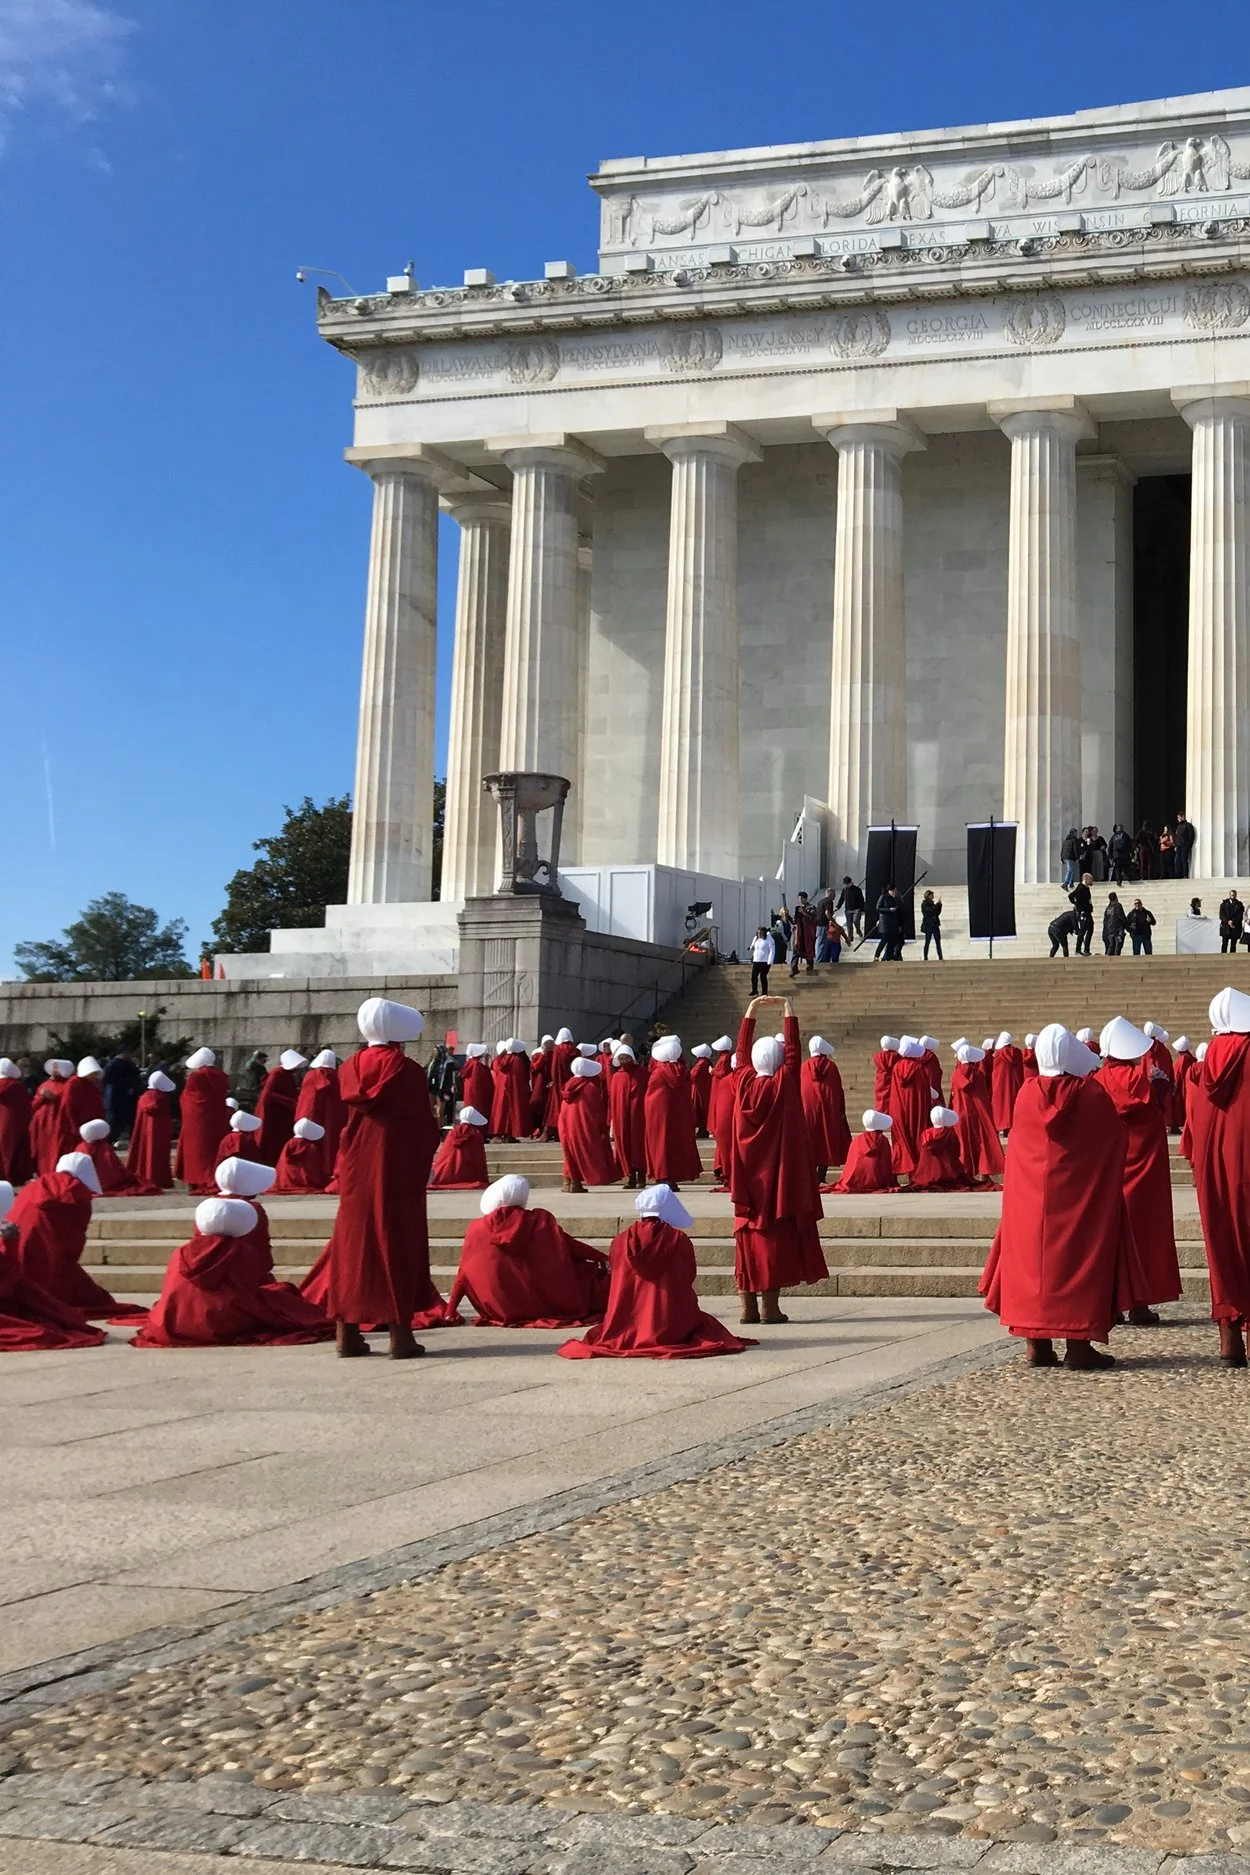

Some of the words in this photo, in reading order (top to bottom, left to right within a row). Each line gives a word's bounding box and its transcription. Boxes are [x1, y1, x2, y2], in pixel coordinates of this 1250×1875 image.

[822, 236, 877, 254] LORIDA
[908, 231, 947, 246] EXAS
[1070, 295, 1181, 322] CONNECTICUT
[906, 312, 989, 335] GEORGIA
[728, 331, 765, 350] NEW
[767, 327, 824, 346] JERSEY
[561, 339, 661, 363] PENNSYLVANIA
[420, 355, 501, 374] DELAWARE
